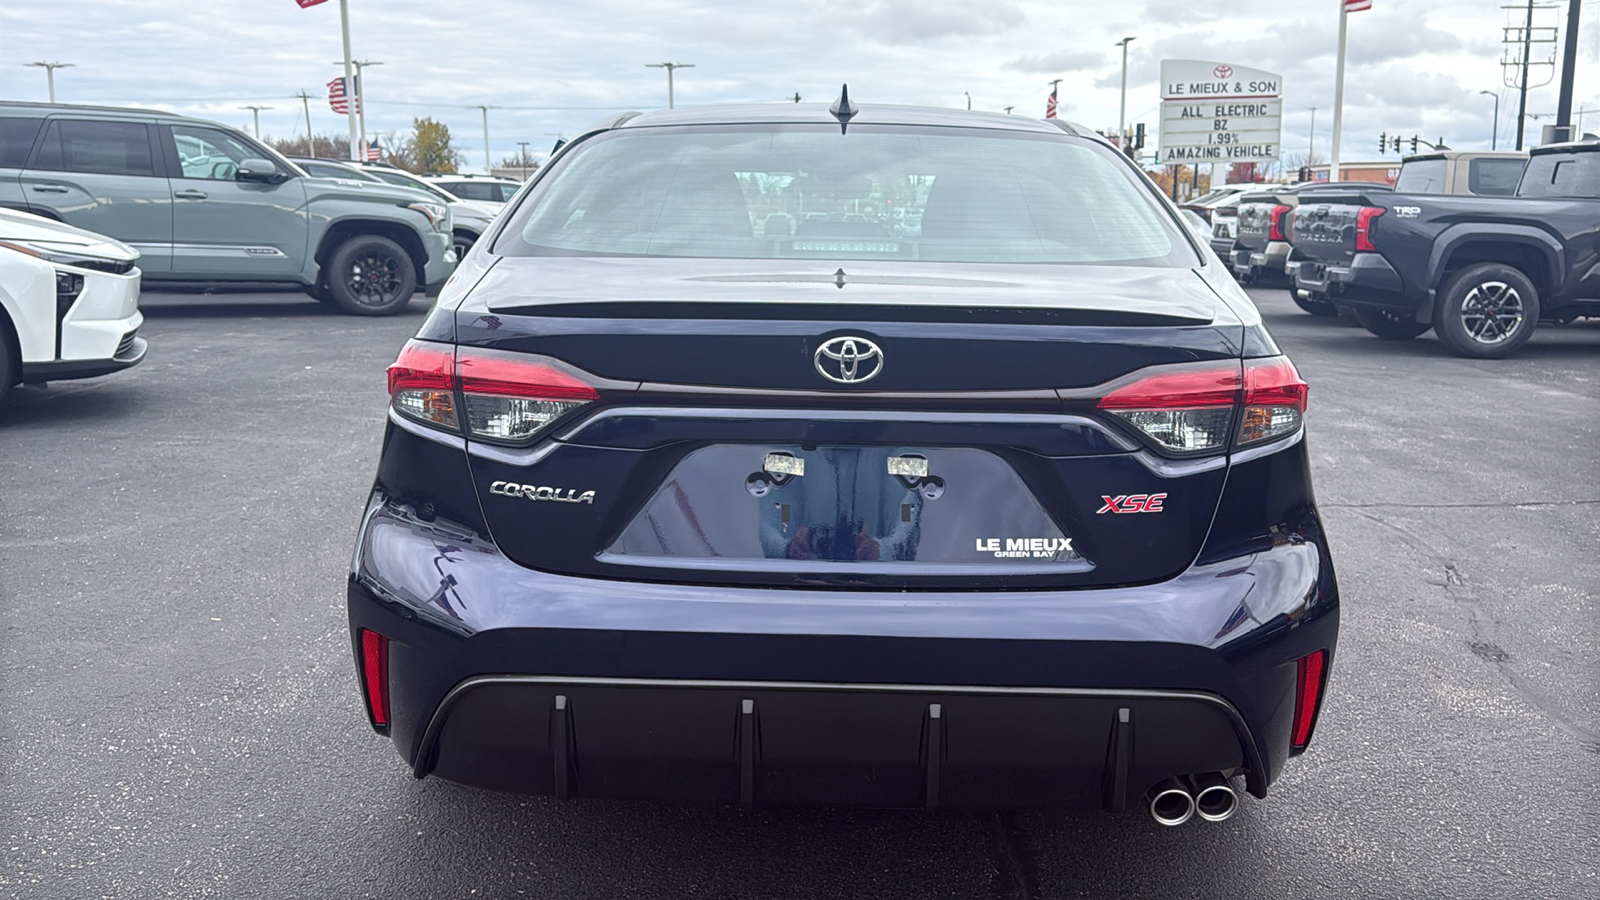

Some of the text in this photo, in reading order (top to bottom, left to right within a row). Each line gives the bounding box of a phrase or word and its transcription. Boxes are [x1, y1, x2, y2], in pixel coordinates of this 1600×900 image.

[1168, 81, 1276, 95] LE MIEUX & SON
[1181, 104, 1267, 119] ALL ELECTRIC
[1213, 119, 1228, 131] BZ
[1208, 133, 1240, 145] 1.99%
[1167, 145, 1272, 160] AMAZING VEHICLE
[1393, 206, 1421, 215] TRD
[489, 480, 596, 504] COROLLA
[1096, 493, 1168, 514] XSE
[976, 538, 1073, 551] LE MIEUX
